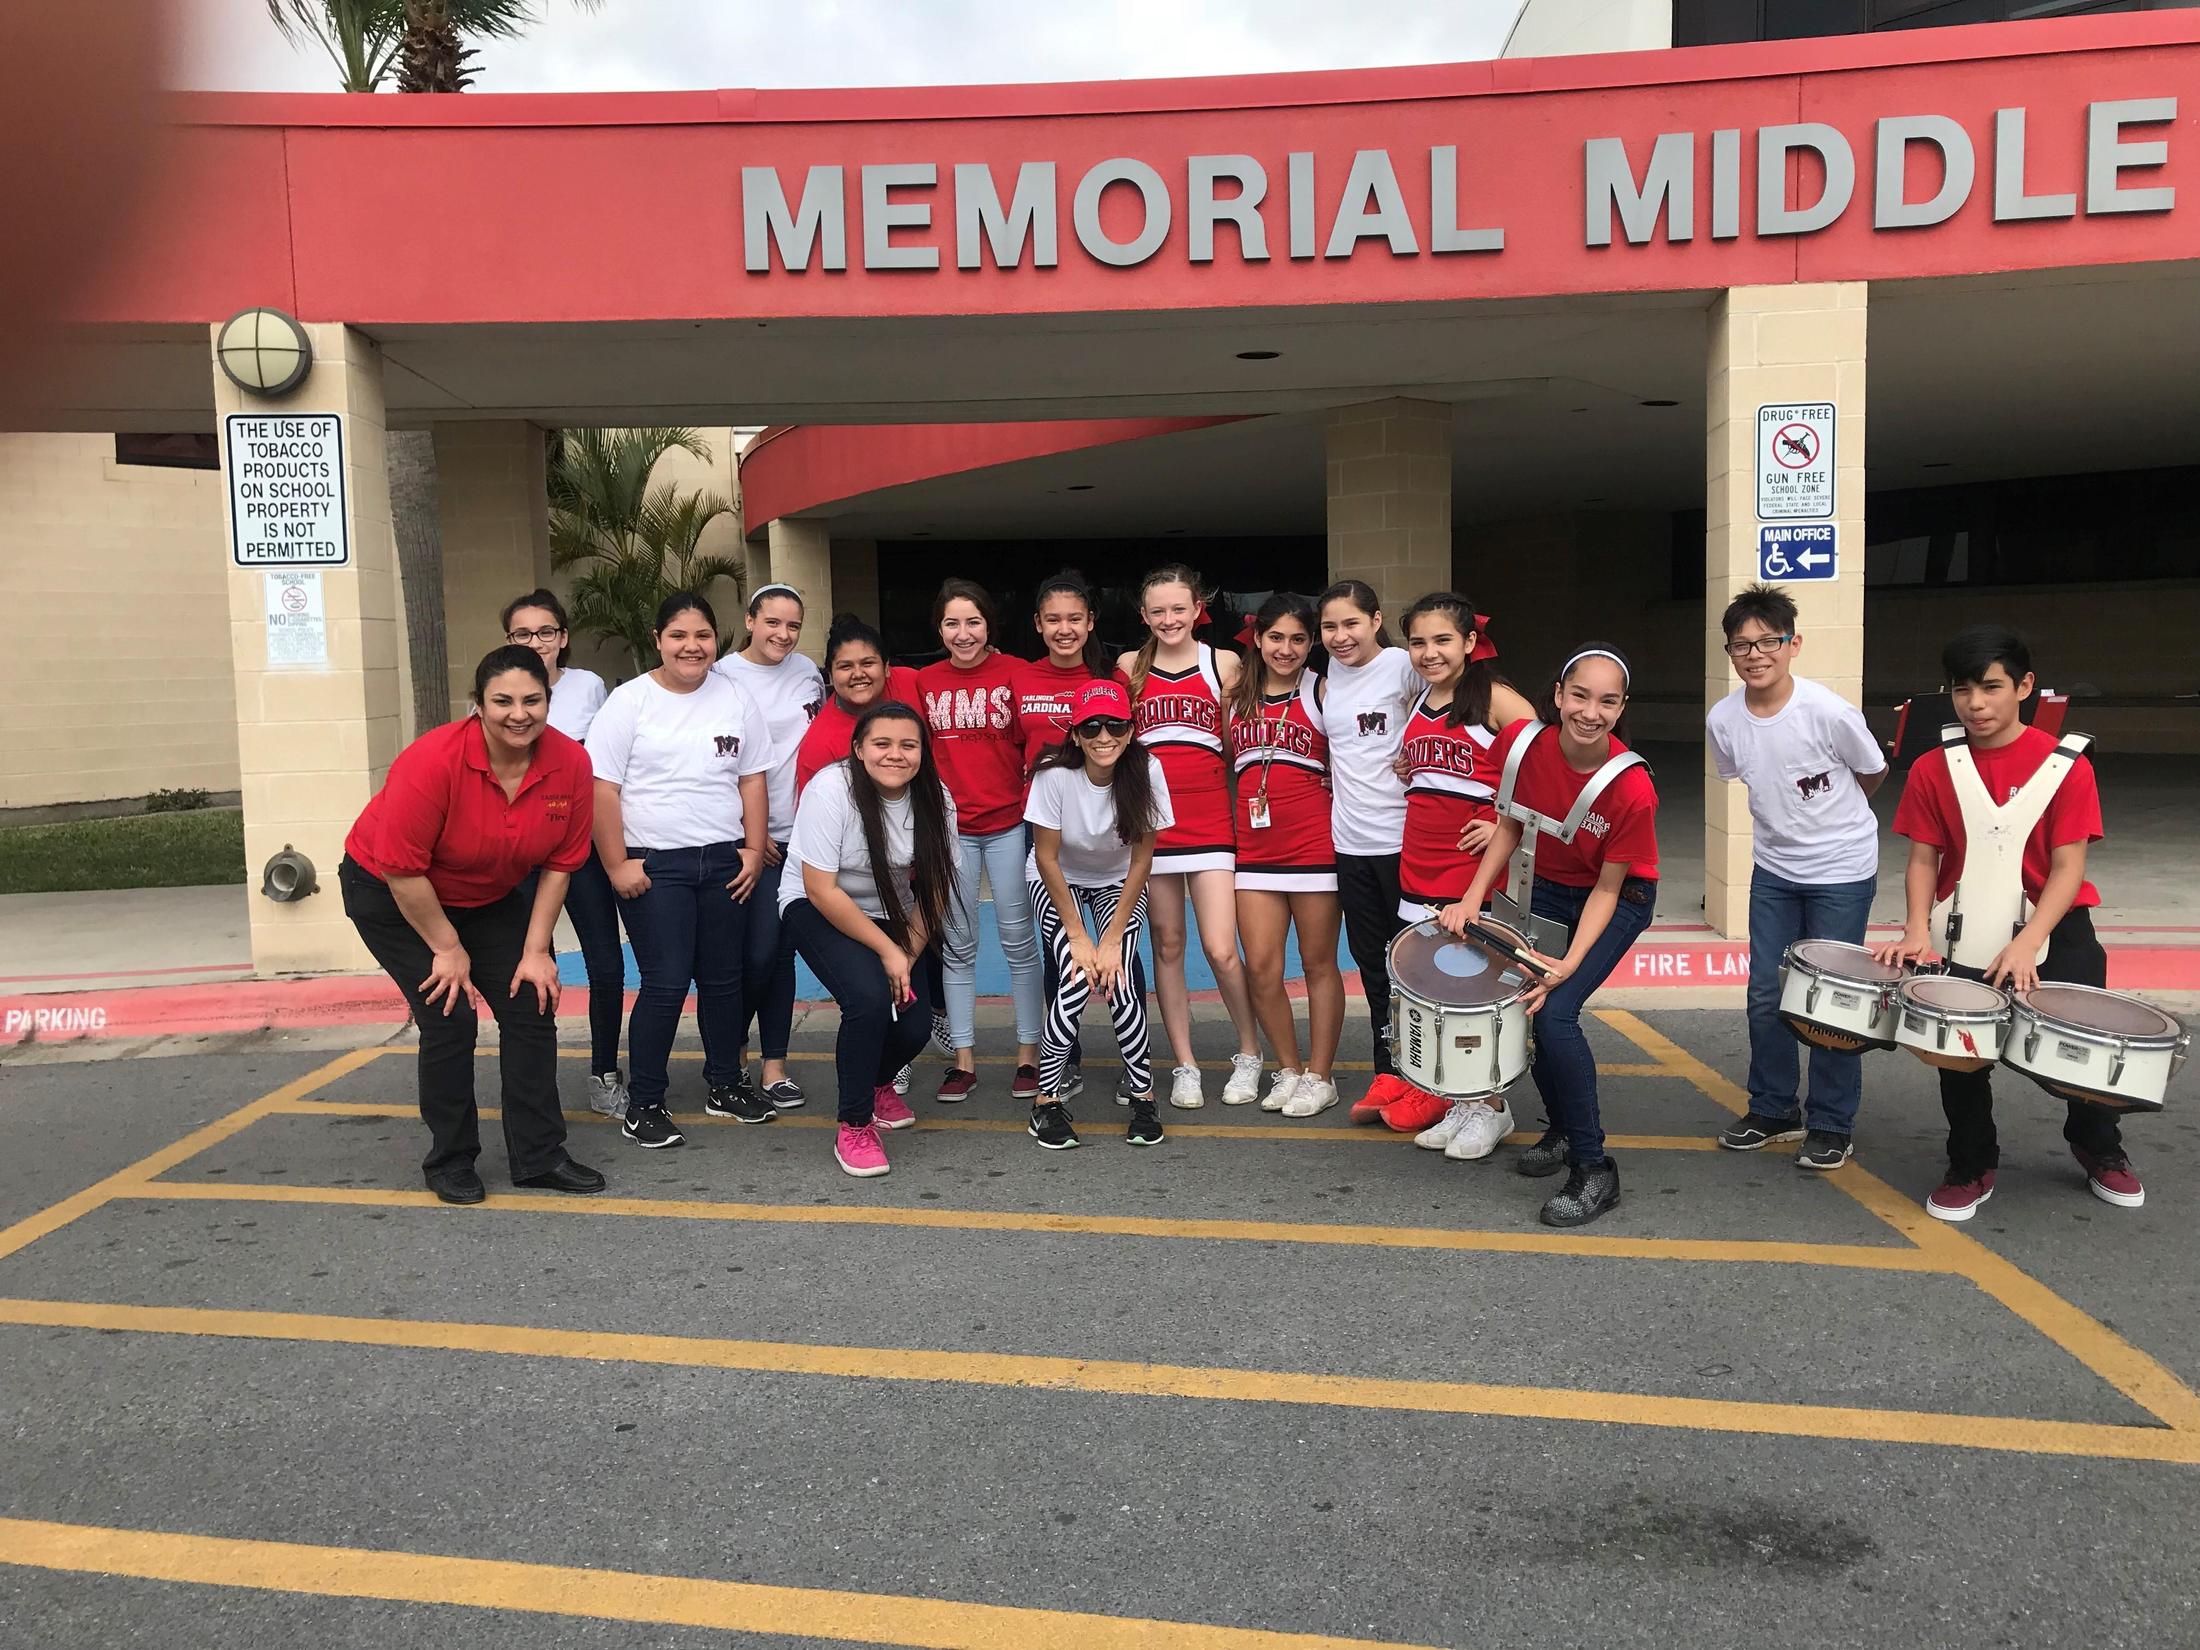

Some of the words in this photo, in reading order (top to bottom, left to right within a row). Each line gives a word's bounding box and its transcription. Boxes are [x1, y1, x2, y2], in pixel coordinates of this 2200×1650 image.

[741, 145, 1505, 272] MEMORIAL
[1585, 97, 2178, 248] MIDDLE
[1763, 410, 1793, 422] DRUG
[1802, 408, 1831, 420] FREE
[237, 422, 268, 438] THE
[274, 420, 305, 438] USE
[311, 422, 331, 438] OF
[248, 442, 323, 458] TOBACCO
[244, 462, 329, 478] PRODUCTS
[1766, 473, 1789, 484] GUN
[1797, 472, 1825, 483] FREE
[240, 483, 263, 498] ON
[269, 482, 335, 498] SCHOOL
[1771, 486, 1798, 494] SCHOOL
[1801, 484, 1820, 493] ZONE
[247, 502, 329, 518] PROPERTY
[264, 523, 278, 538] IS
[284, 522, 316, 538] NOT
[1764, 529, 1791, 542] MAIN
[1793, 527, 1831, 541] OFFICE
[246, 542, 336, 558] PERMITTED
[269, 613, 286, 626] NO
[925, 686, 1011, 731] MMS
[1021, 703, 1072, 714] CARDINA
[1136, 694, 1215, 734] RAIDERS
[1231, 718, 1312, 757] RAIDERS
[1406, 735, 1474, 776] AIDERS
[1634, 953, 1691, 976] FIRE
[1706, 952, 1750, 976] LAN
[5, 1007, 107, 1033] PARKING
[1410, 1022, 1422, 1069] YAMAHA
